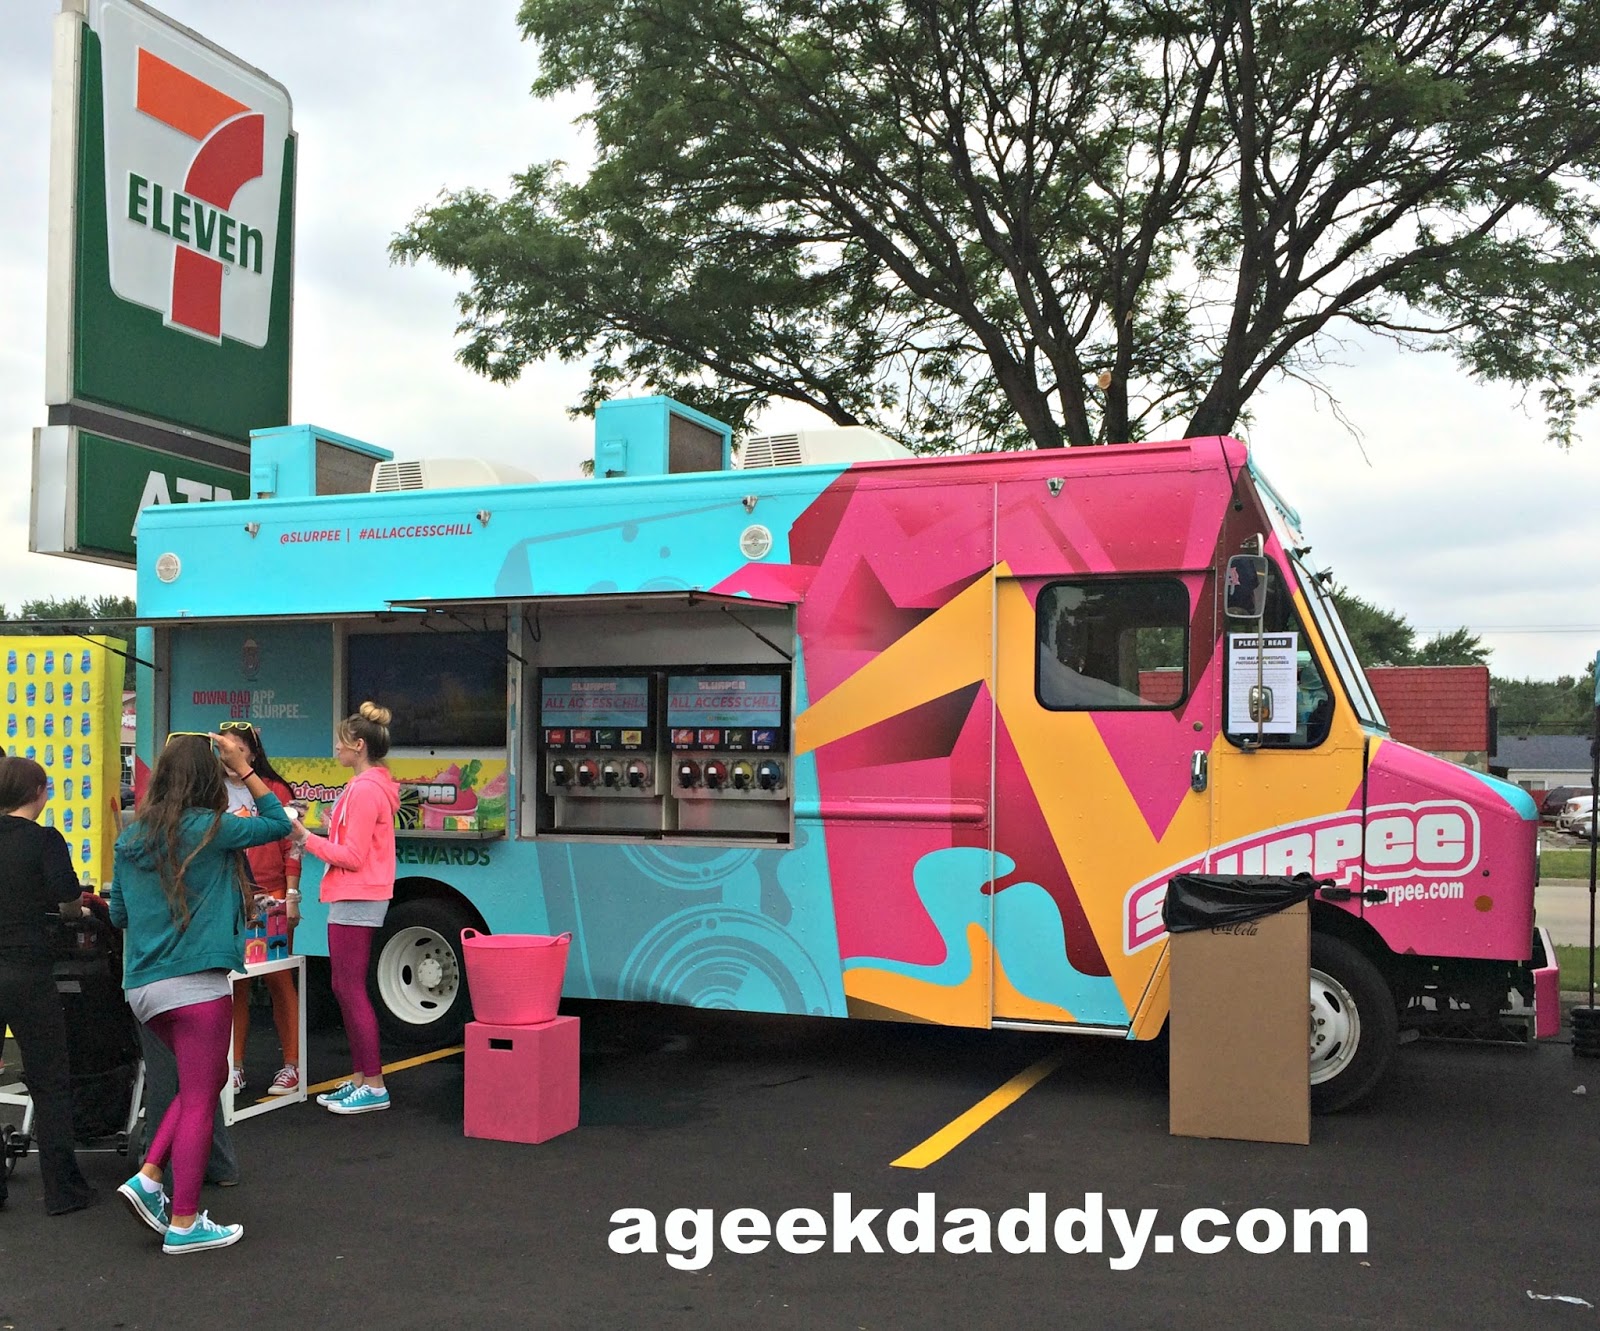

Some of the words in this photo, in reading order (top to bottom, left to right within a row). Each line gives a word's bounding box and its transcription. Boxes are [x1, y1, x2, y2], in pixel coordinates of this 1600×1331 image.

[280, 530, 341, 545] @SLURPEE
[359, 523, 473, 541] #ALLACCESSCHILL
[192, 690, 251, 705] DOWNLOAD
[252, 690, 275, 704] APP
[545, 697, 565, 708] ALL
[568, 696, 612, 708] ACCESS
[670, 696, 691, 708] ALL
[694, 696, 741, 708] ACCESS
[230, 705, 250, 718] GET
[252, 704, 299, 718] SLURPEE
[291, 783, 349, 801] aterme
